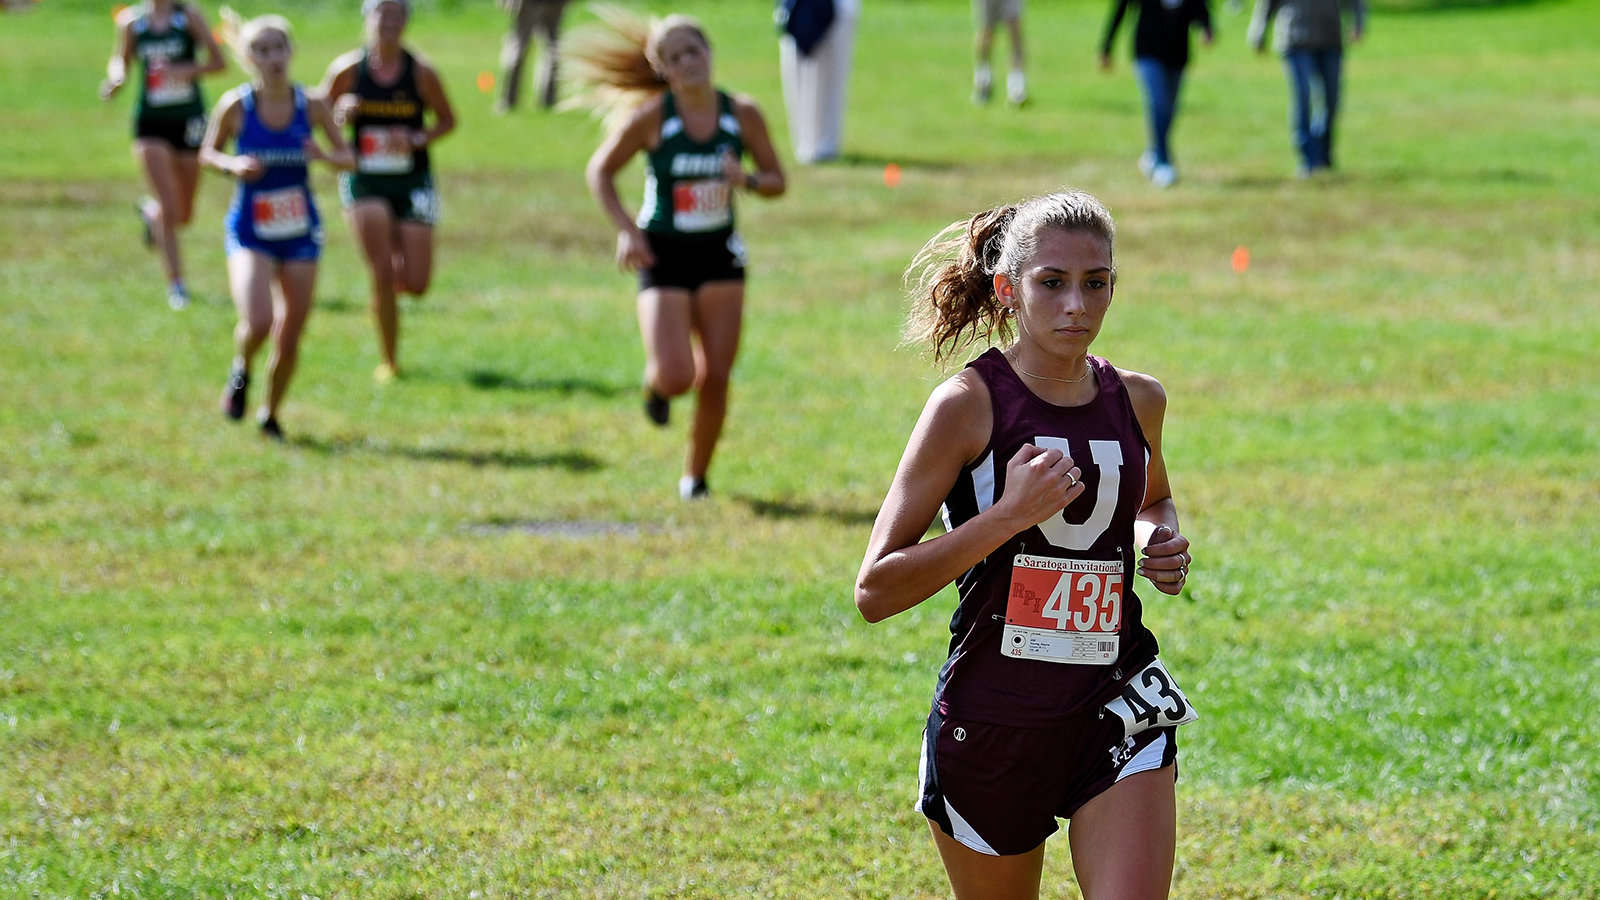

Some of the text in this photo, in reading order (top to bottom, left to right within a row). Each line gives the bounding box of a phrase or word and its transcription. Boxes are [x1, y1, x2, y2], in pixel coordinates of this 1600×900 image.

[1034, 436, 1123, 551] U
[1023, 556, 1119, 573] Saratoga Invitational
[1012, 582, 1042, 613] RPI
[1042, 573, 1122, 632] 435
[1011, 648, 1022, 656] 435
[1121, 666, 1192, 727] 43
